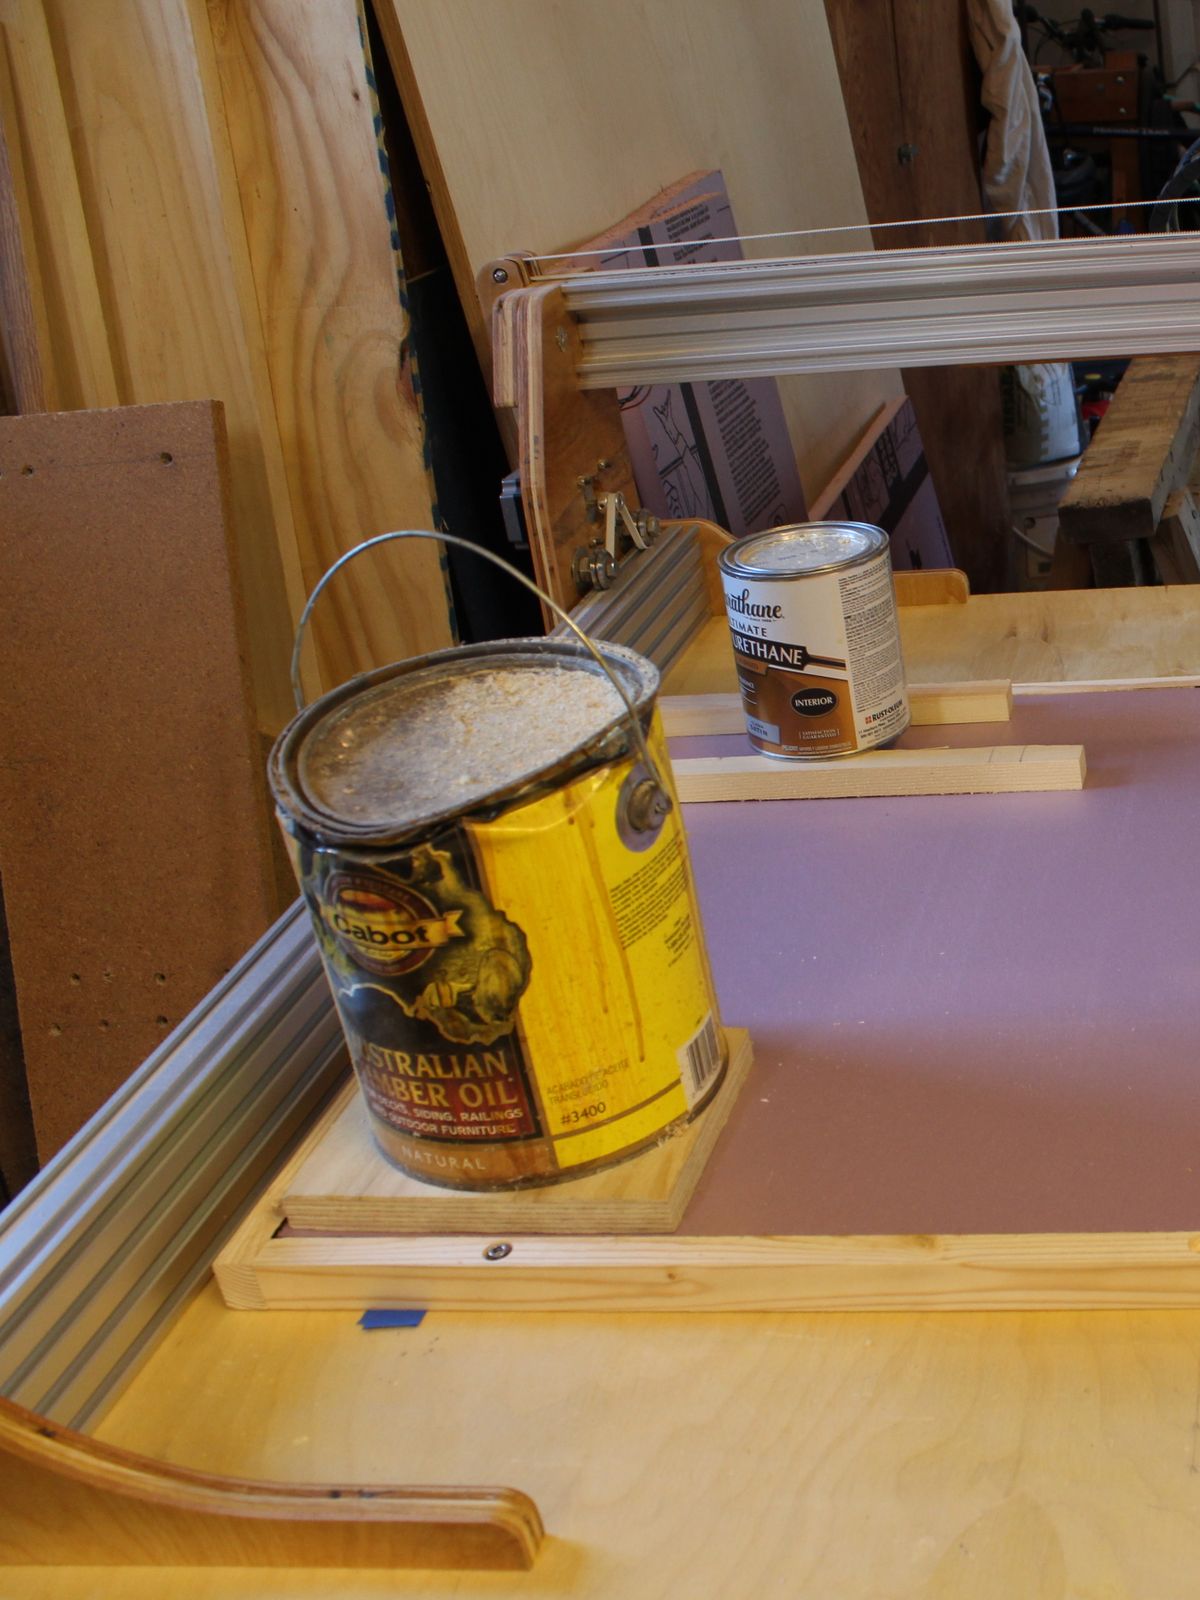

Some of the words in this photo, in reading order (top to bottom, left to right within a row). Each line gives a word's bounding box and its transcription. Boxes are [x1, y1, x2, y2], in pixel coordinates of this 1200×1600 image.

[726, 588, 784, 619] rathane
[731, 617, 767, 638] TIMATE
[733, 633, 803, 665] URETHANE
[795, 696, 834, 707] INTERIOR
[334, 914, 431, 945] Cabot
[363, 1042, 509, 1079] STRALIAN
[367, 1064, 450, 1107] MBER
[458, 1080, 519, 1108] OIL
[412, 1107, 457, 1123] SIDING,
[460, 1108, 523, 1123] RAILINGS
[560, 1101, 607, 1126] #3400
[441, 1124, 516, 1137] FURNITURE
[401, 1145, 486, 1171] NATURAL
